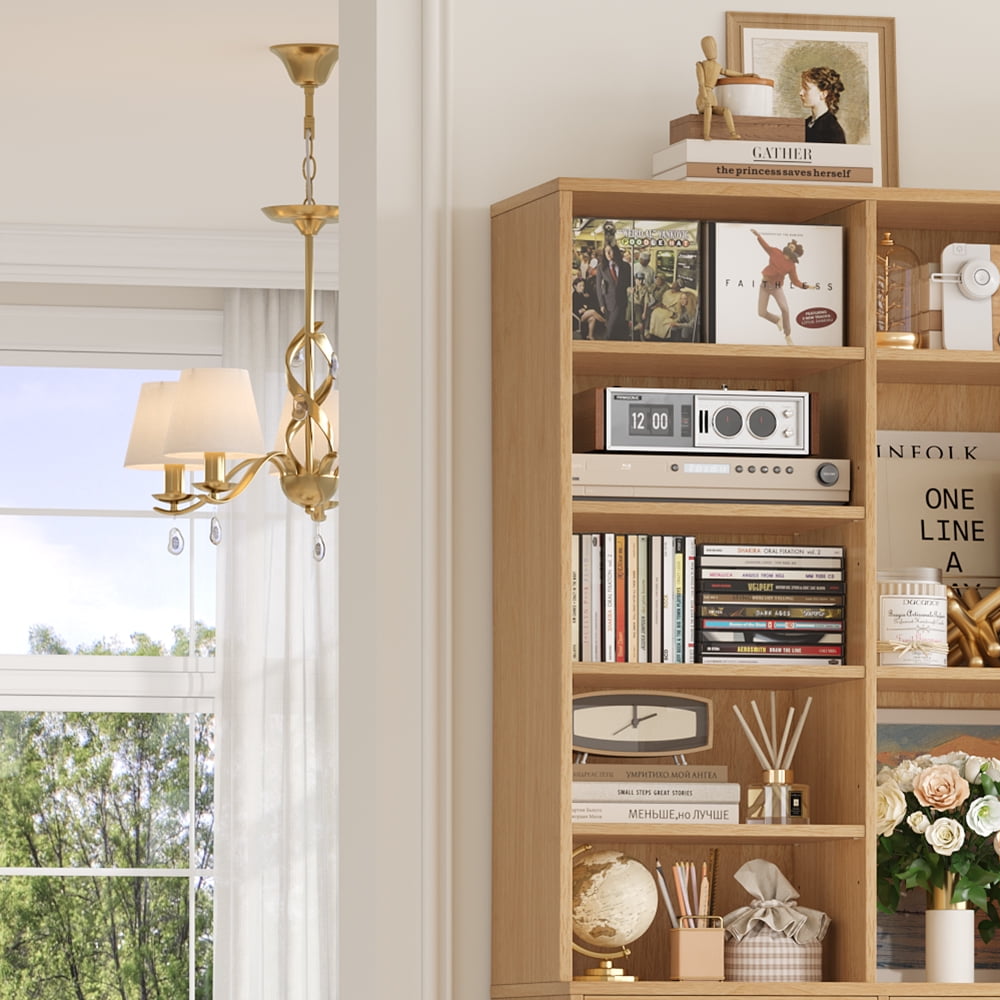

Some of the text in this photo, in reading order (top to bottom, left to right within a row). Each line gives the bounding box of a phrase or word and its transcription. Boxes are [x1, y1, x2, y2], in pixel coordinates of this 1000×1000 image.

[752, 146, 812, 160] GATHER
[716, 166, 851, 178] the princess saves herself
[725, 279, 833, 291] FAITHLESS
[632, 412, 668, 430] 12 00
[926, 488, 975, 510] ONE
[920, 519, 985, 541] LINE
[946, 551, 963, 573] A
[692, 809, 730, 820] ЛУЧШЕ
